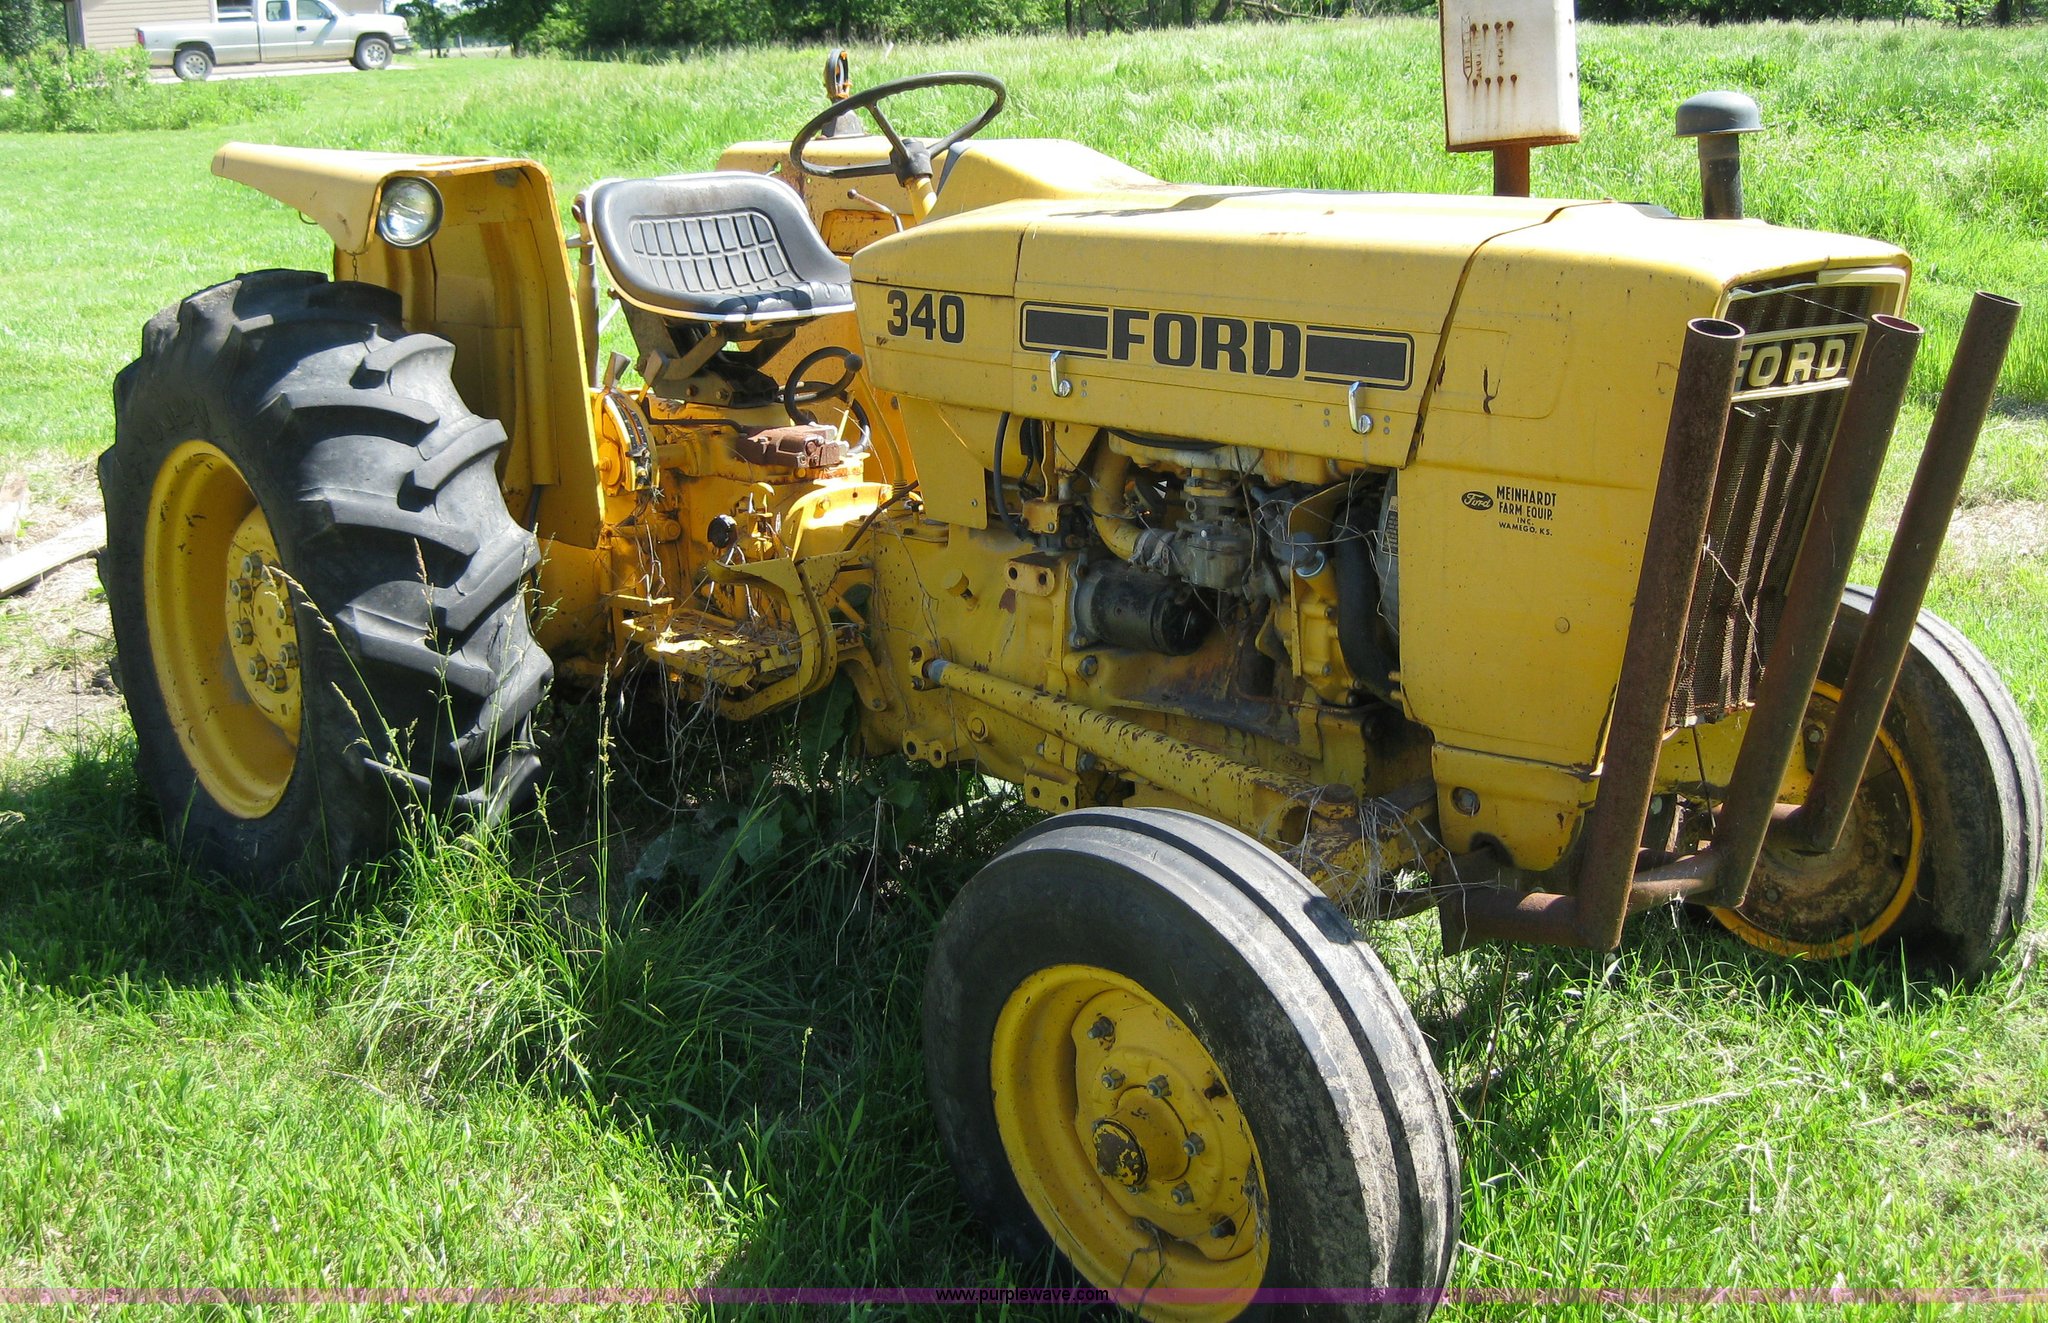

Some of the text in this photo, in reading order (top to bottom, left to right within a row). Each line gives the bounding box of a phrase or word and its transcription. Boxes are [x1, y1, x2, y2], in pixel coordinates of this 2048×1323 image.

[886, 290, 965, 344] 340
[1112, 308, 1301, 379] FORD
[1463, 492, 1492, 508] Ford
[1496, 486, 1556, 506] MEINHARDT
[1499, 501, 1553, 521] FARM EQUIP.
[1517, 517, 1534, 526] INC.
